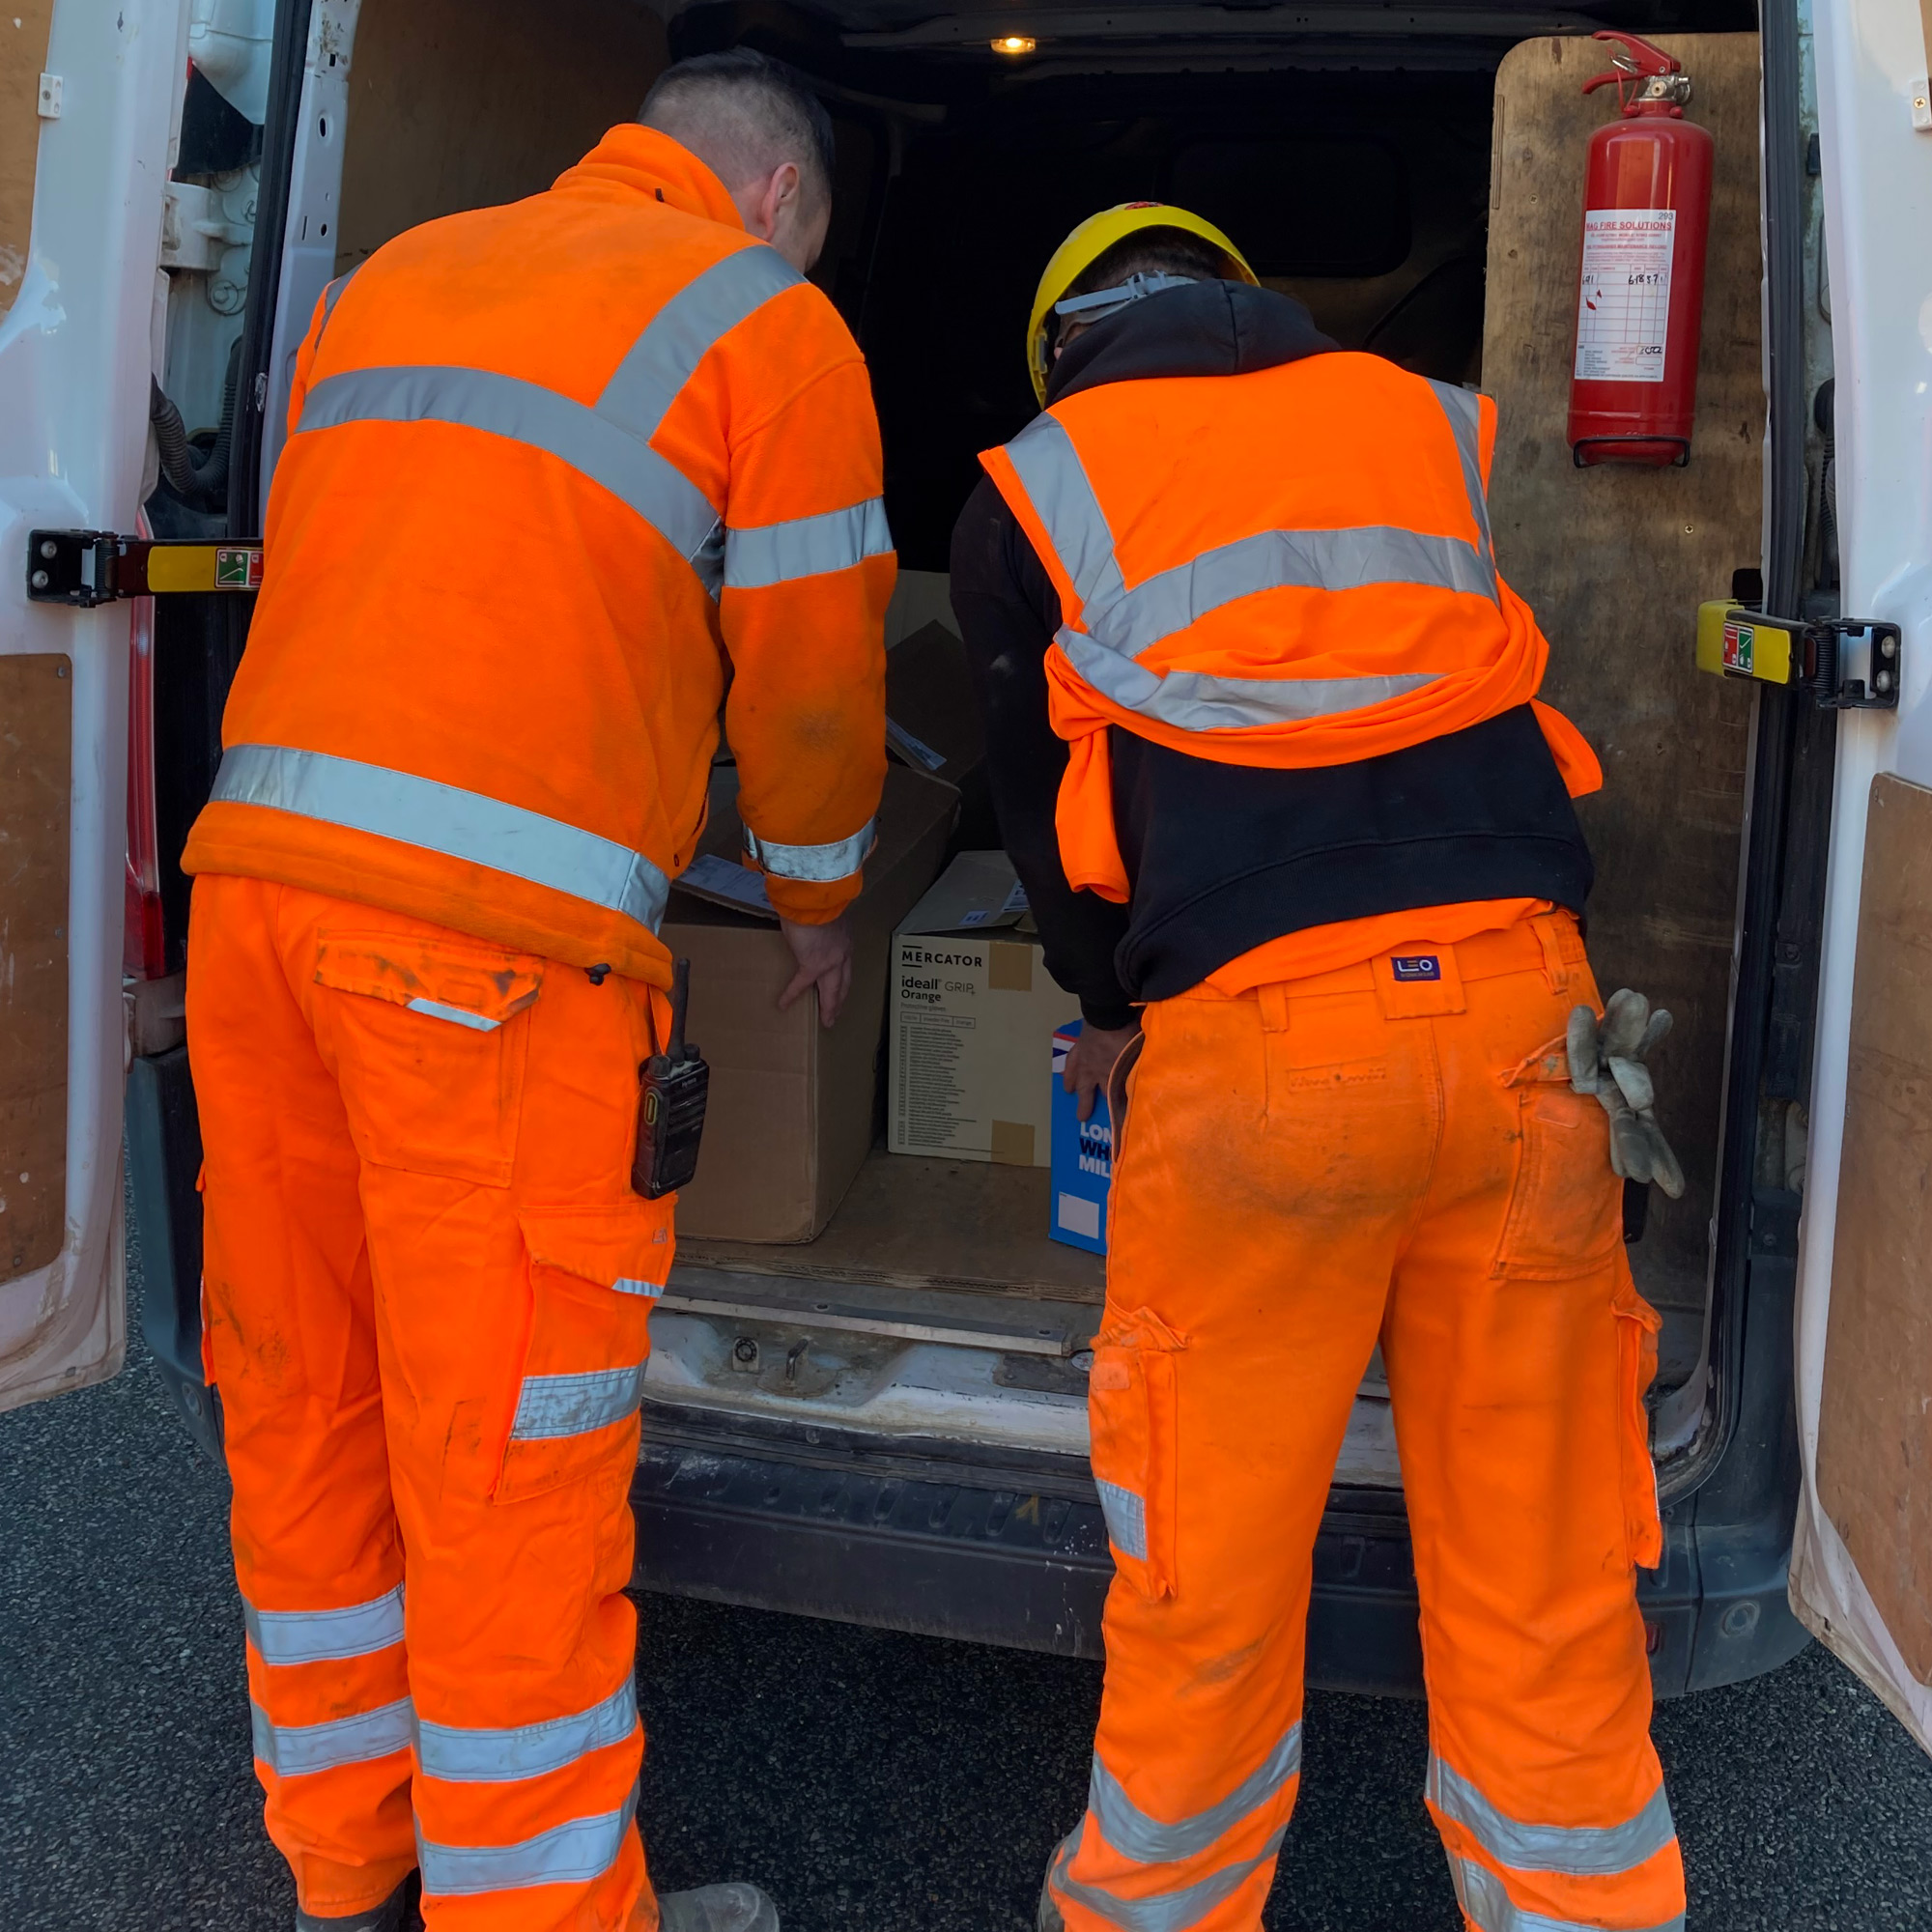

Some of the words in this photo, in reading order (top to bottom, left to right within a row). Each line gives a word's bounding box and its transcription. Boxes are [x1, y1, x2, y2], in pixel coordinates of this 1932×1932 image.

[1658, 212, 1674, 220] 293
[1600, 221, 1617, 230] FIRE
[1619, 221, 1672, 231] SOLUTIONS
[901, 951, 982, 967] MERCATOR
[1397, 959, 1433, 973] LEO
[901, 989, 942, 1004] Orange
[1080, 1121, 1112, 1144] LON
[1079, 1138, 1112, 1161] WH
[1078, 1154, 1111, 1179] MIL
